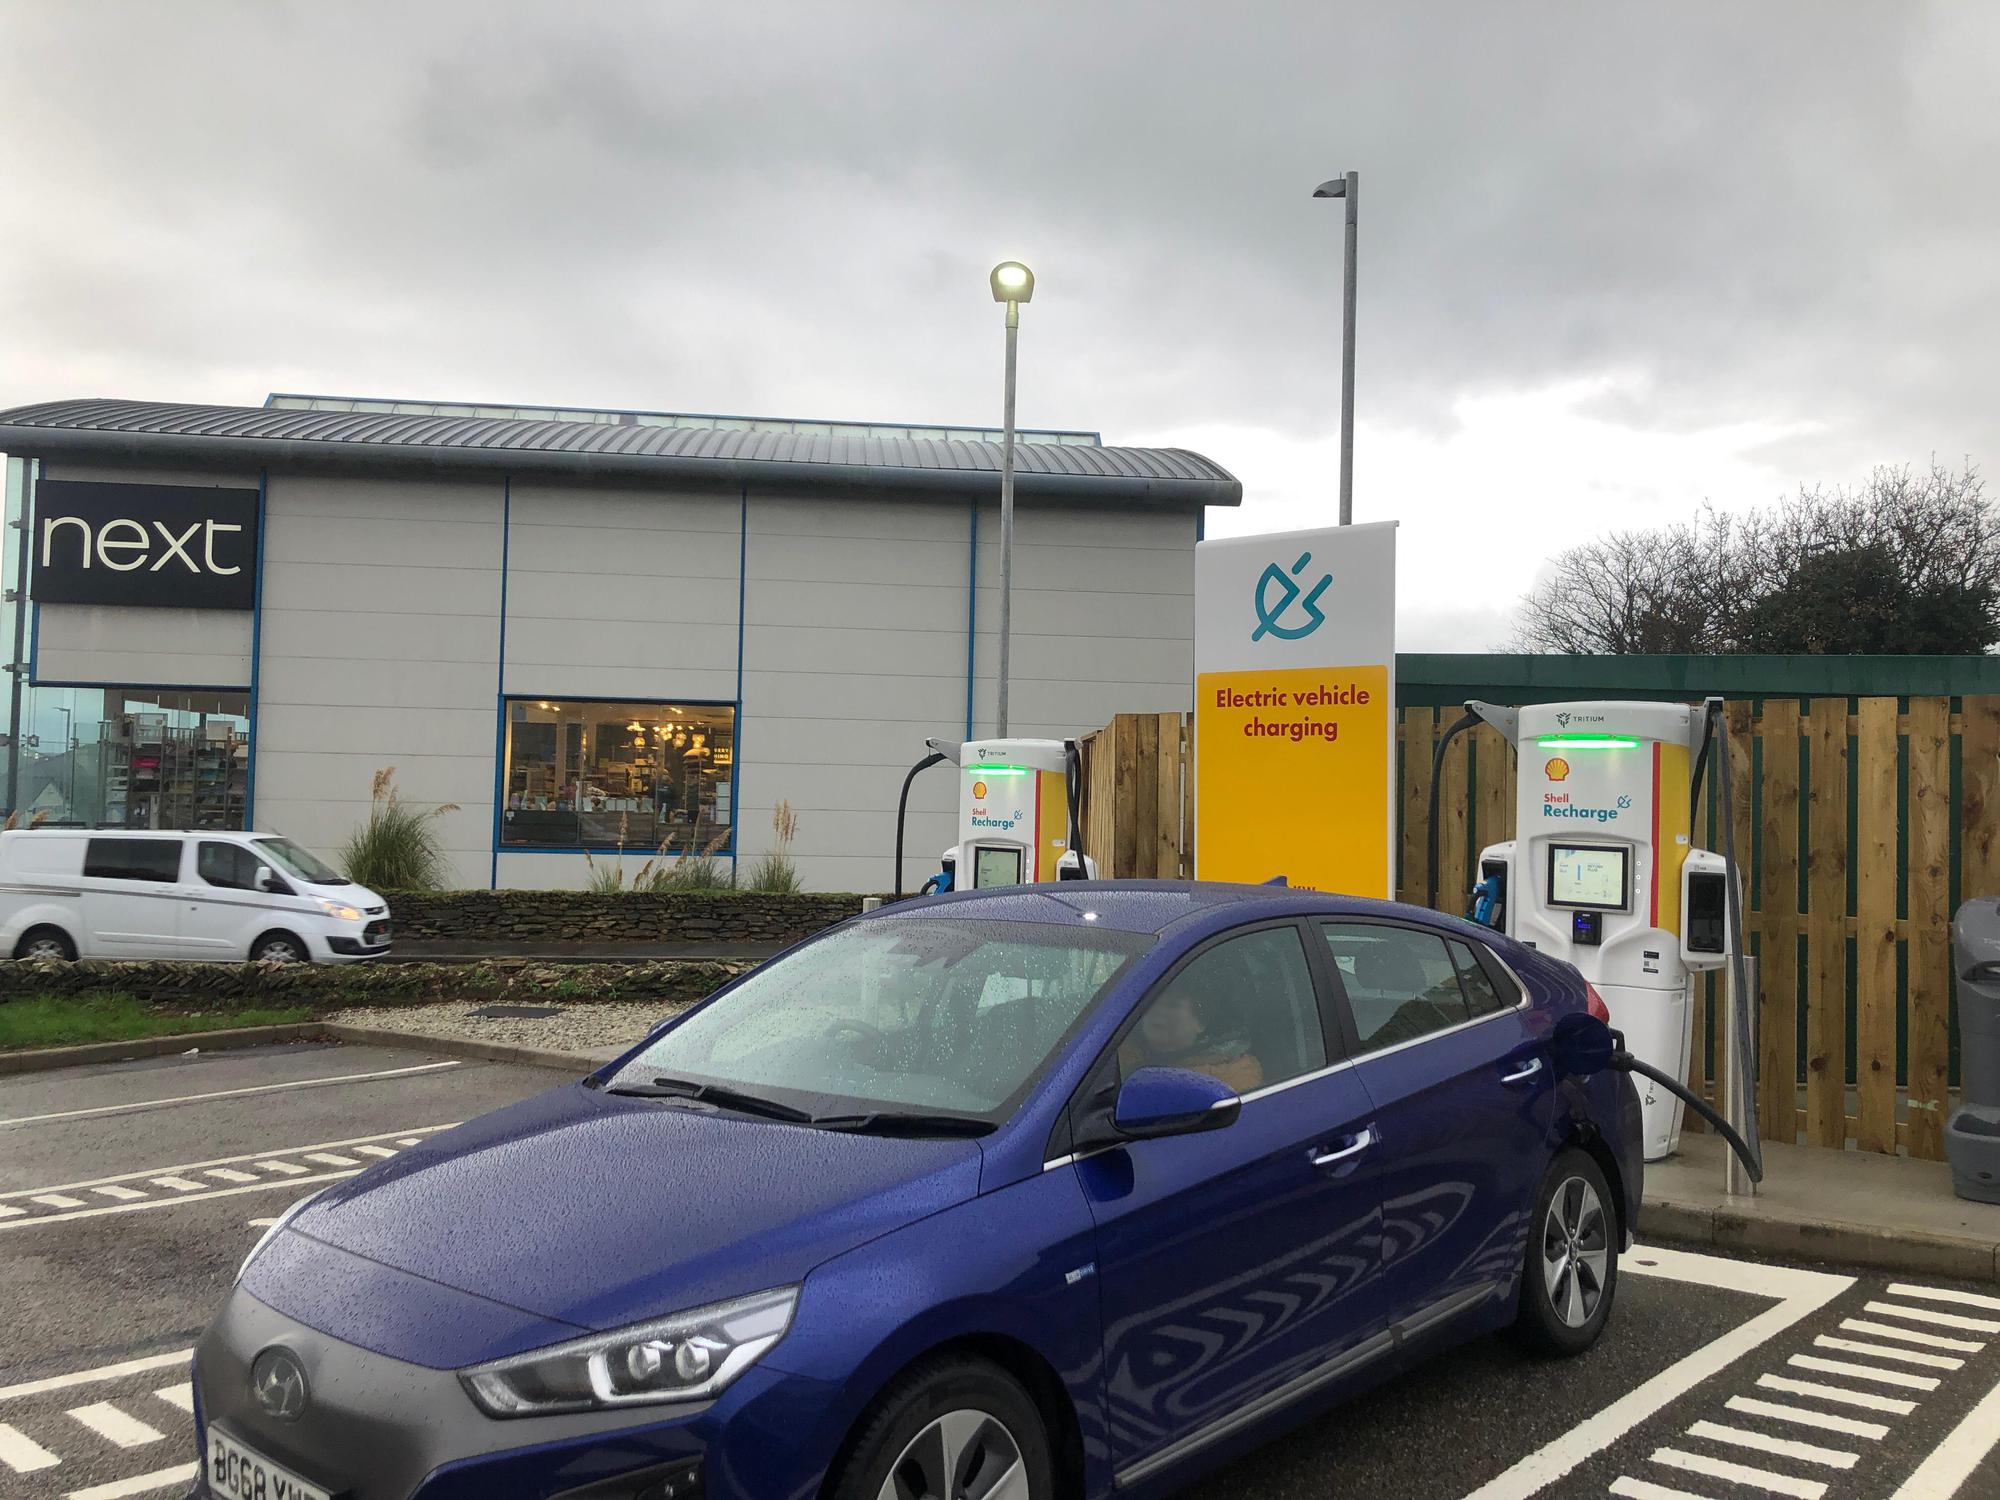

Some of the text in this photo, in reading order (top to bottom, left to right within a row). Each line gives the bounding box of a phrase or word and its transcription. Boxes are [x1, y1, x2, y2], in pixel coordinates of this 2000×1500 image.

[42, 516, 242, 575] next
[1216, 684, 1370, 708] Electric vehicle
[1243, 716, 1338, 742] charging
[1544, 793, 1569, 803] Shell
[972, 808, 987, 816] Shell
[1543, 804, 1618, 822] Recharge
[972, 816, 1014, 829] Recharge
